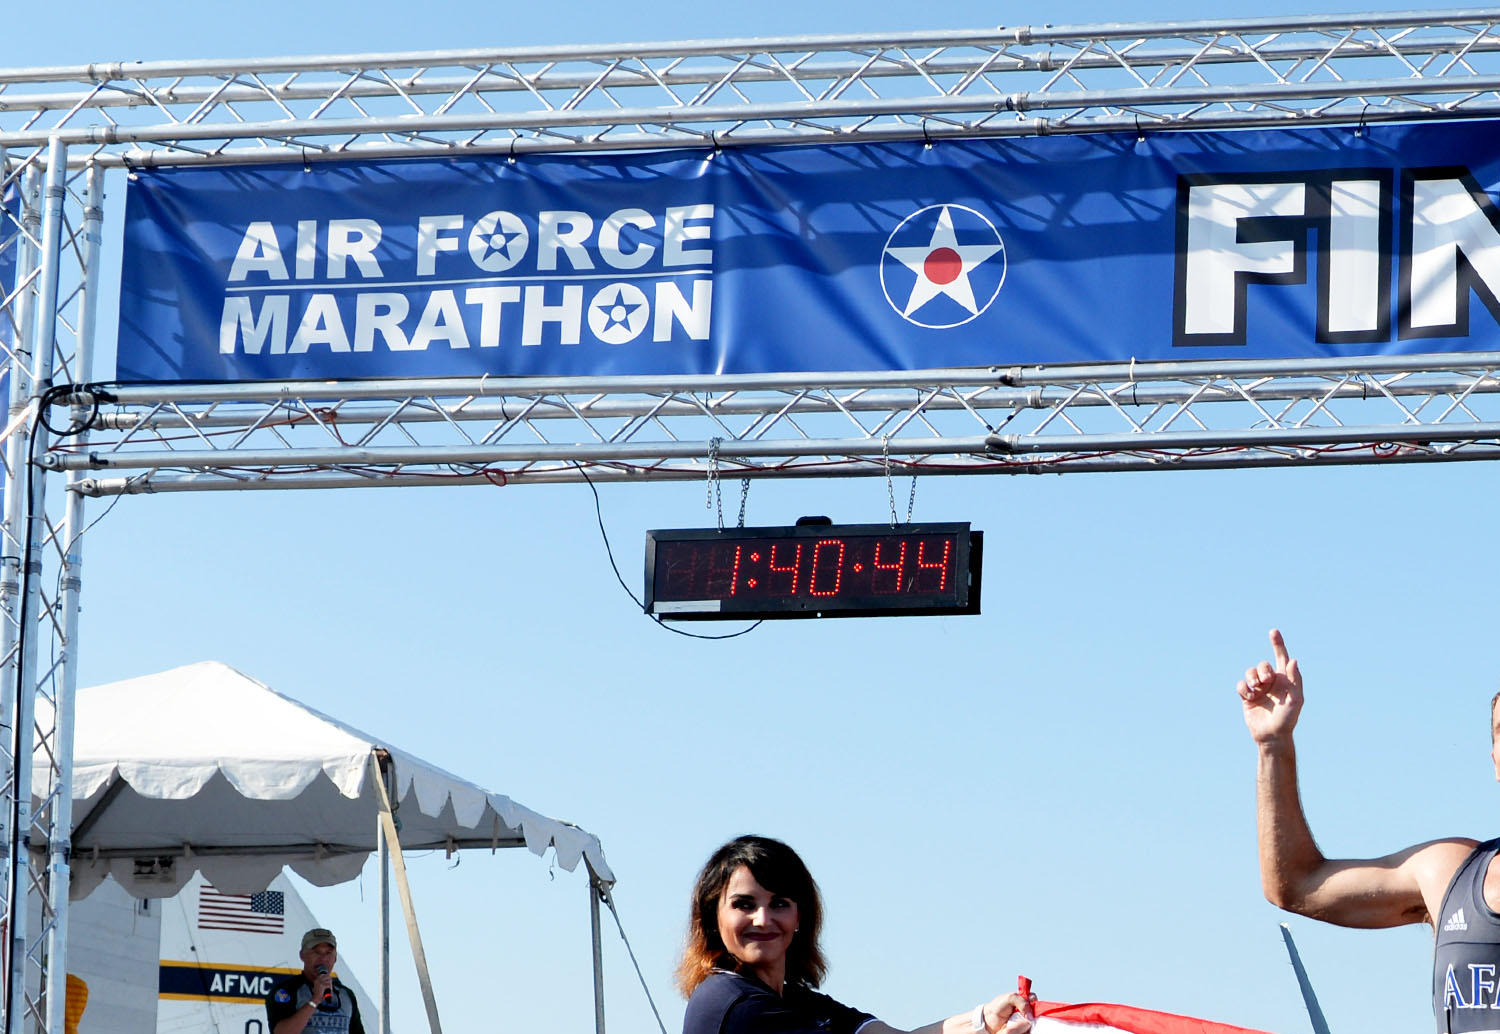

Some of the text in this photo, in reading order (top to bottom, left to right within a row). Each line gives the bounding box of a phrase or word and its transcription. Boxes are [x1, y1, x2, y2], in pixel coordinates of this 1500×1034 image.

[227, 203, 714, 282] AIR FORCE
[219, 279, 712, 355] MARATHON
[1444, 923, 1467, 931] adidas
[210, 973, 274, 995] AFMC
